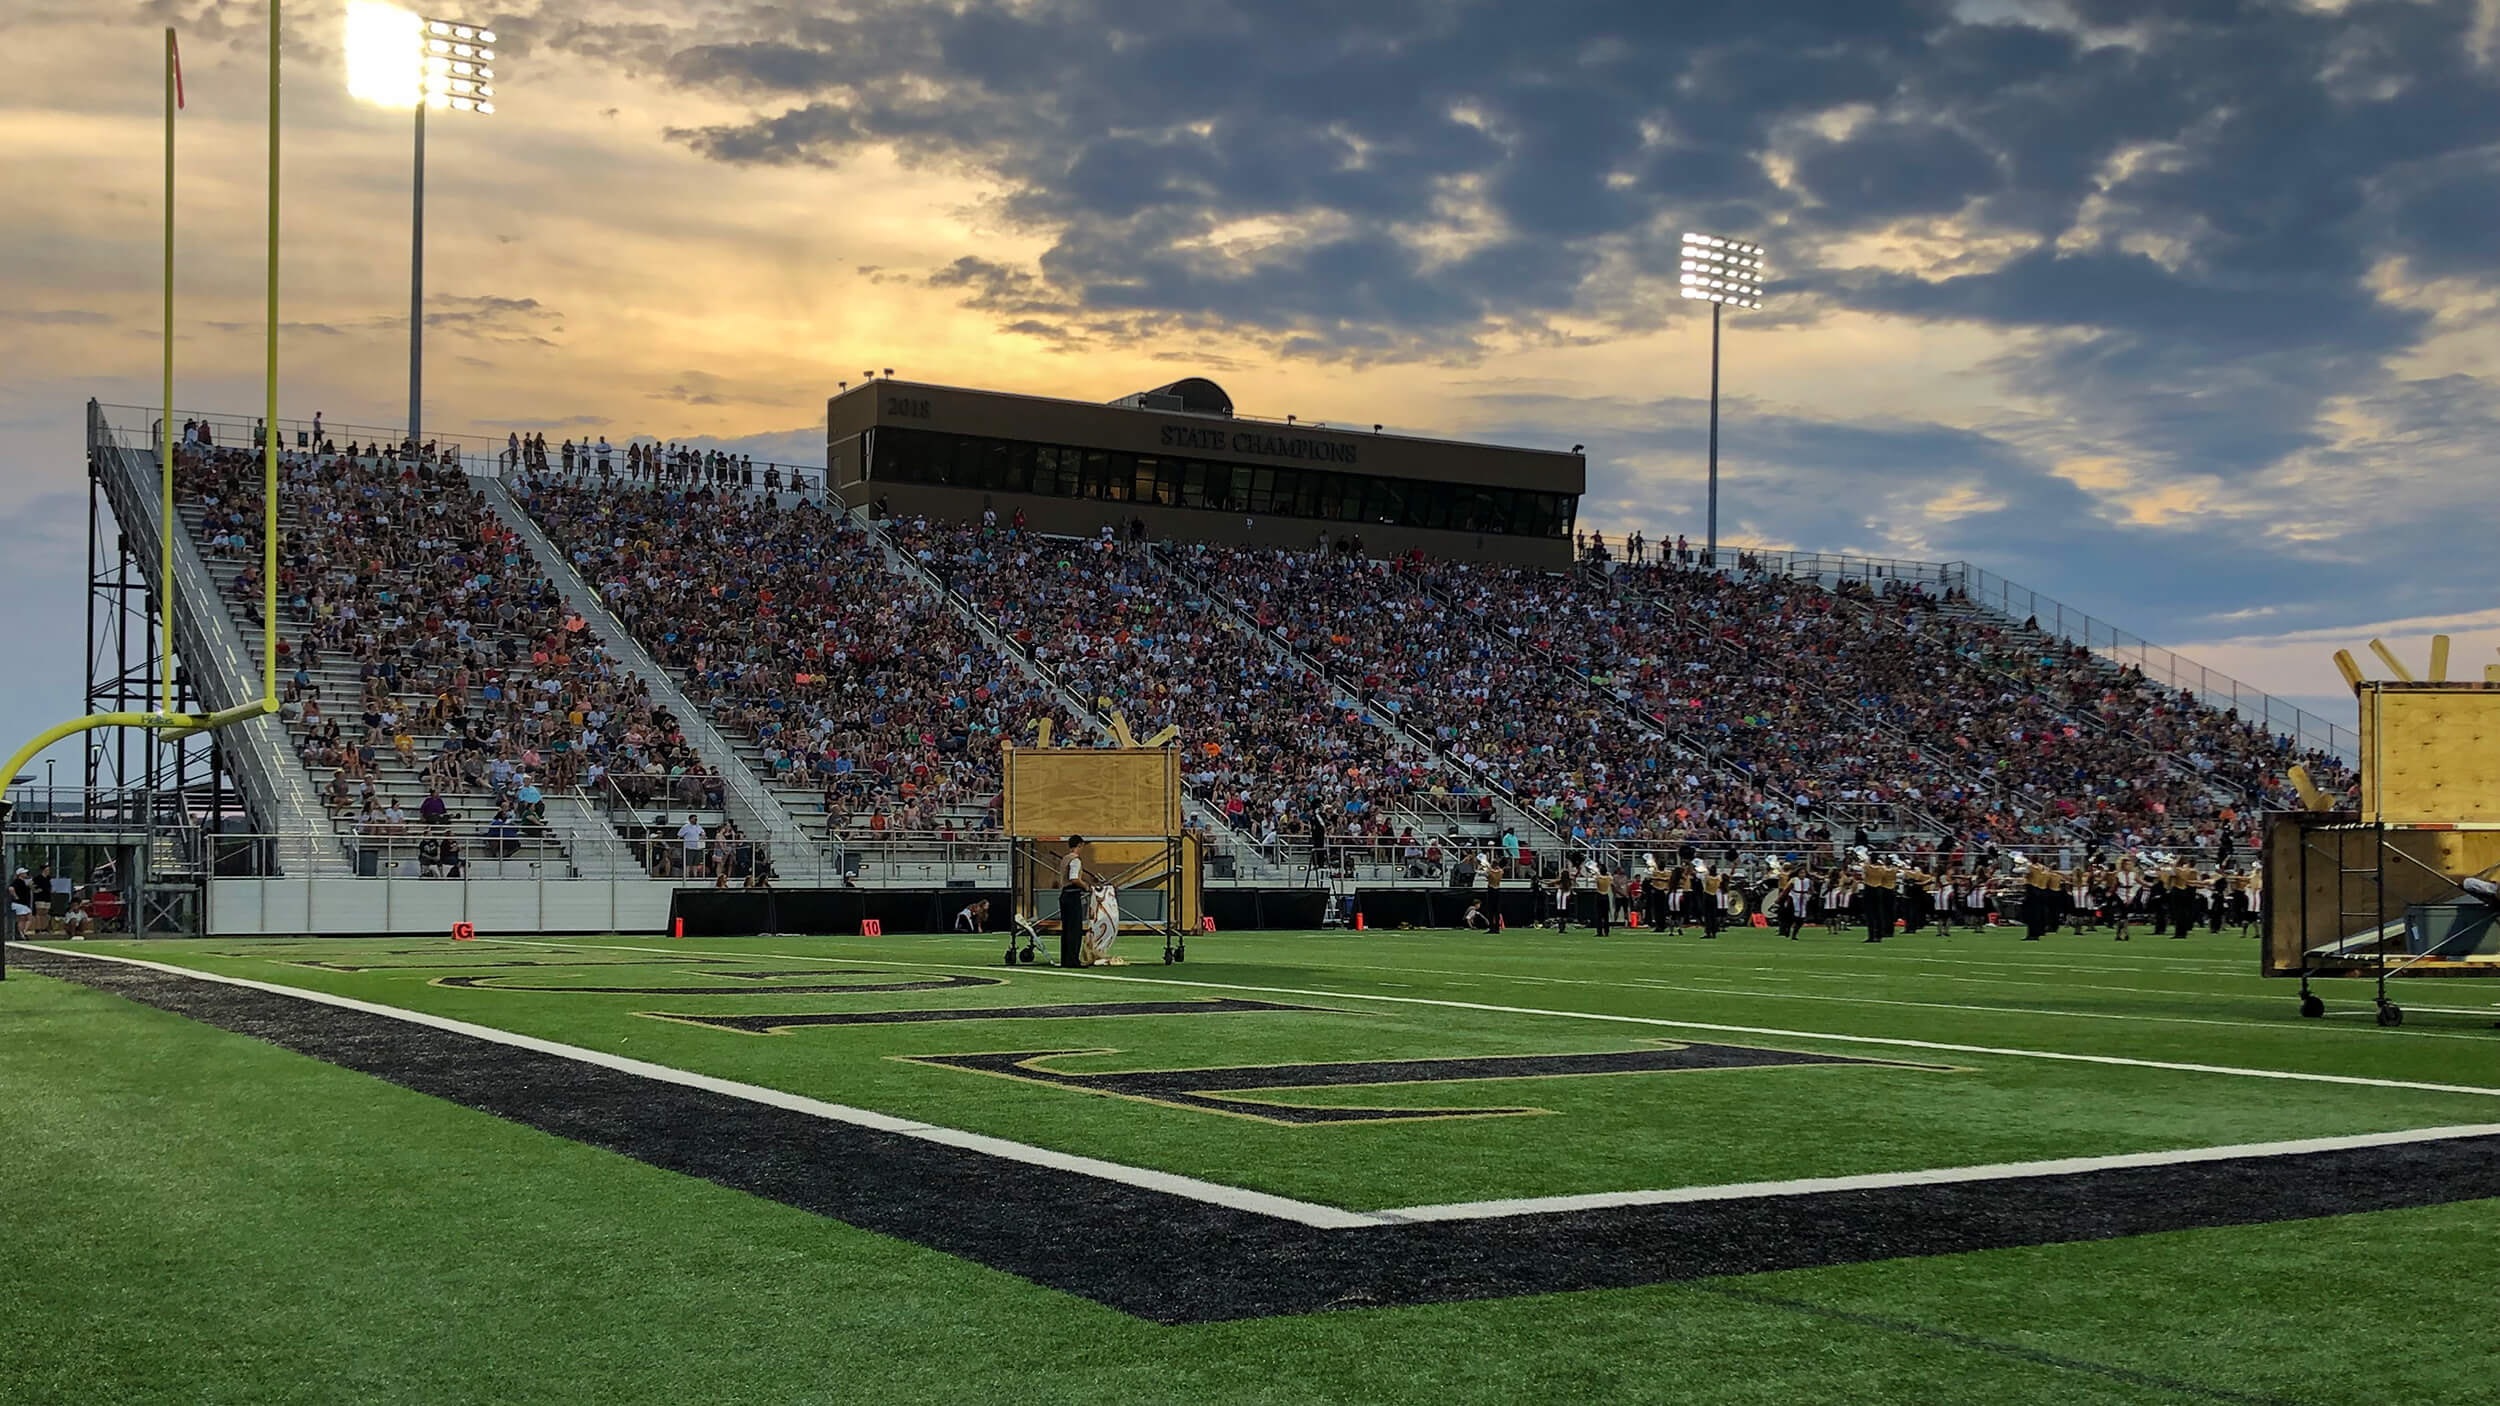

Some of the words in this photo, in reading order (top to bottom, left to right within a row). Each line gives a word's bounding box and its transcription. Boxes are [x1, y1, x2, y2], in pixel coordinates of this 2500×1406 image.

[887, 397, 930, 418] 2018
[1160, 424, 1226, 450] STATE
[1232, 432, 1357, 464] CHAMPIONS
[457, 923, 473, 938] G
[865, 920, 879, 935] 10
